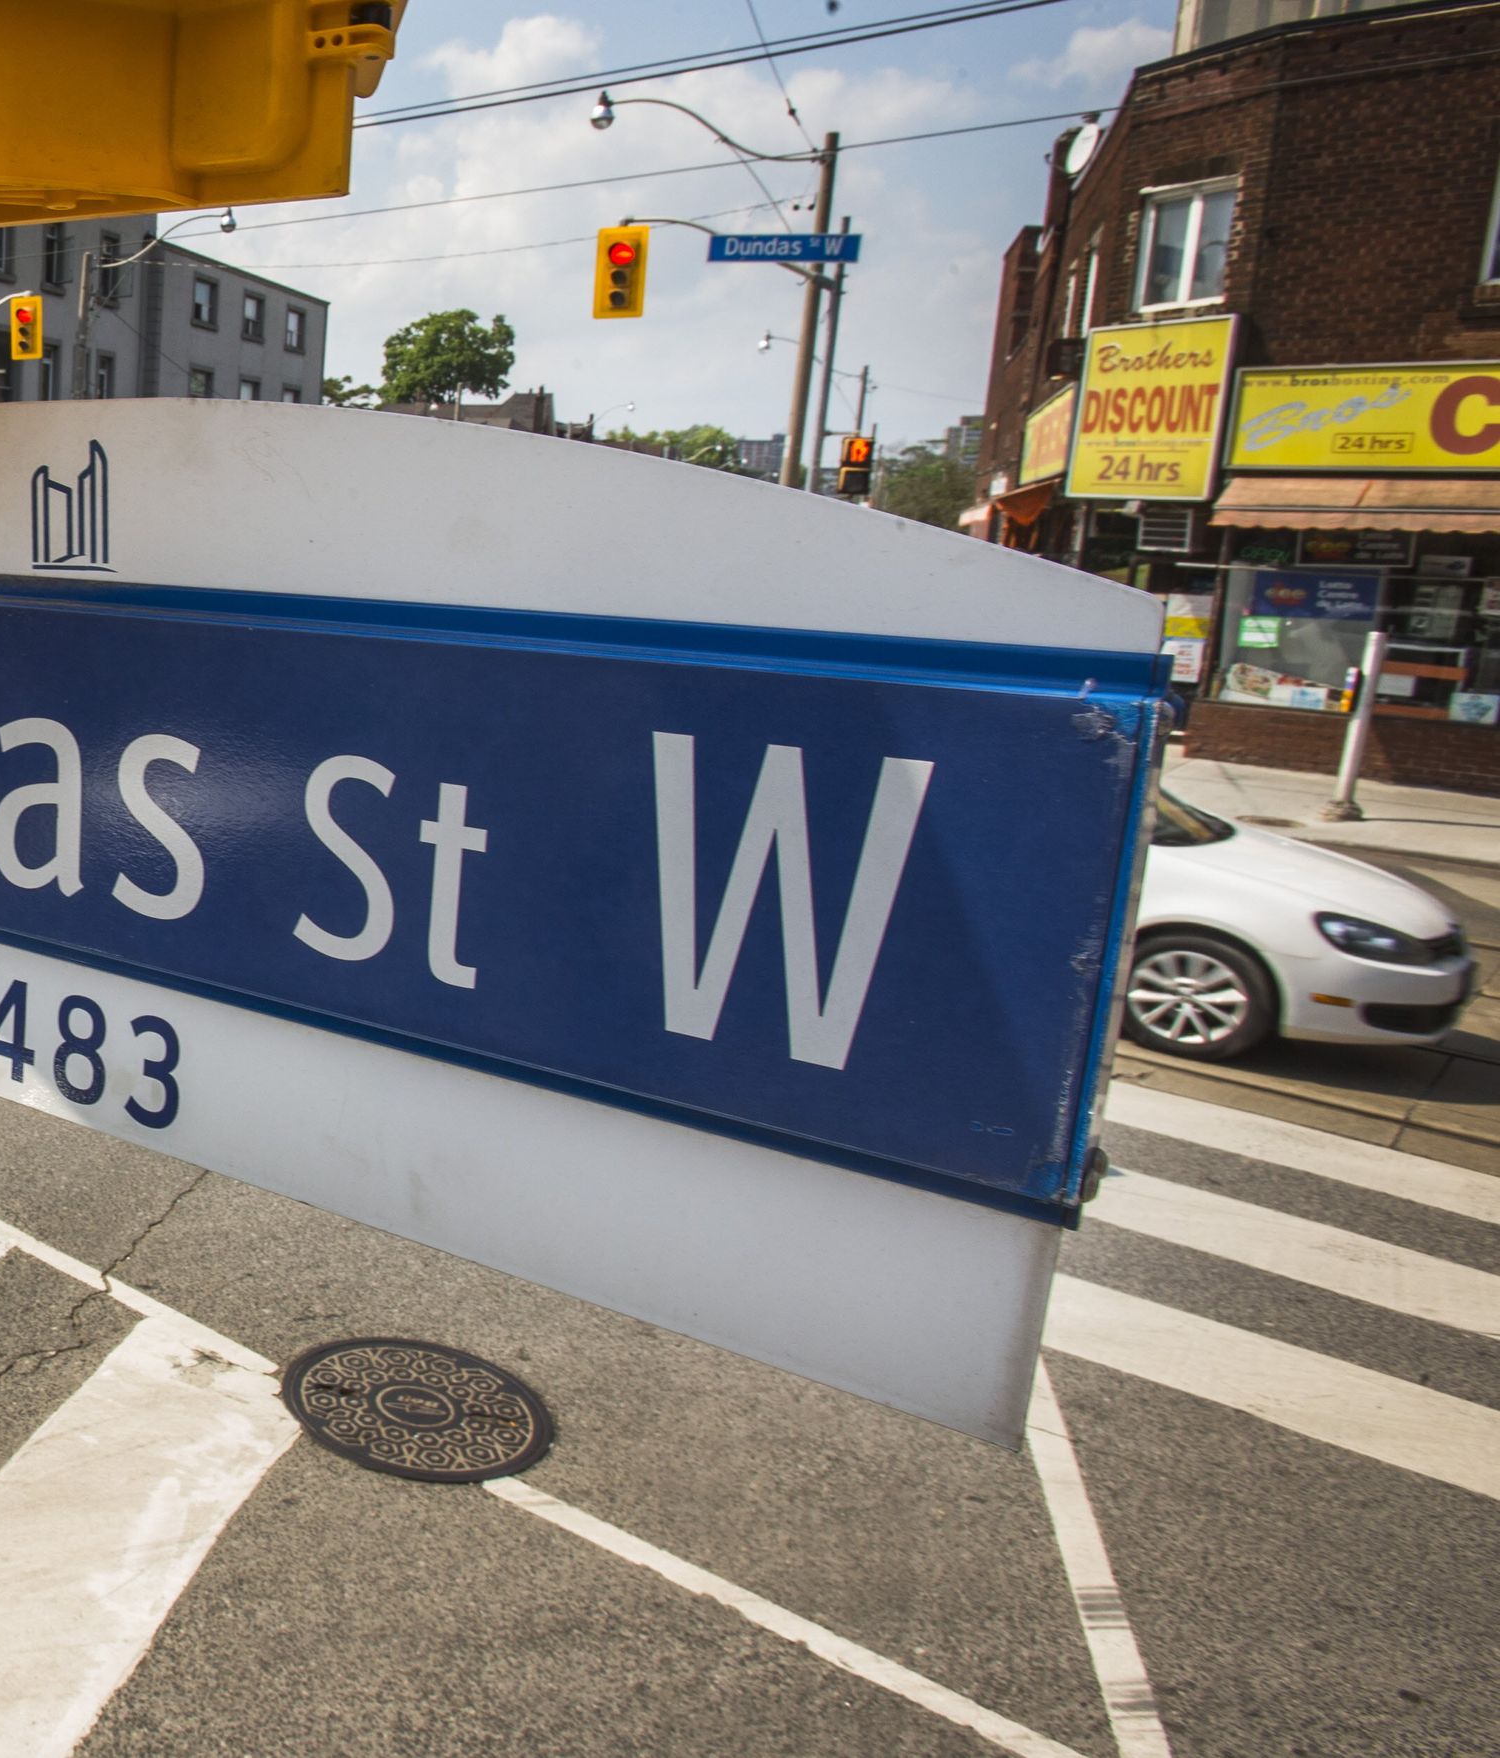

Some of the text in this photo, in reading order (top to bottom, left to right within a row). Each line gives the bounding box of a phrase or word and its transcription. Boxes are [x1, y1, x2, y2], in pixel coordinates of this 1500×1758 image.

[724, 237, 802, 256] Dundas
[824, 237, 844, 256] W
[1097, 341, 1215, 373] Brothers
[1082, 383, 1220, 434] DISCOUNT
[1241, 384, 1413, 451] Bros
[1429, 375, 1500, 455] C
[1337, 436, 1406, 450] 24 hrs
[1097, 454, 1181, 482] 24 hrs
[291, 754, 489, 989] St
[652, 730, 935, 1071] W
